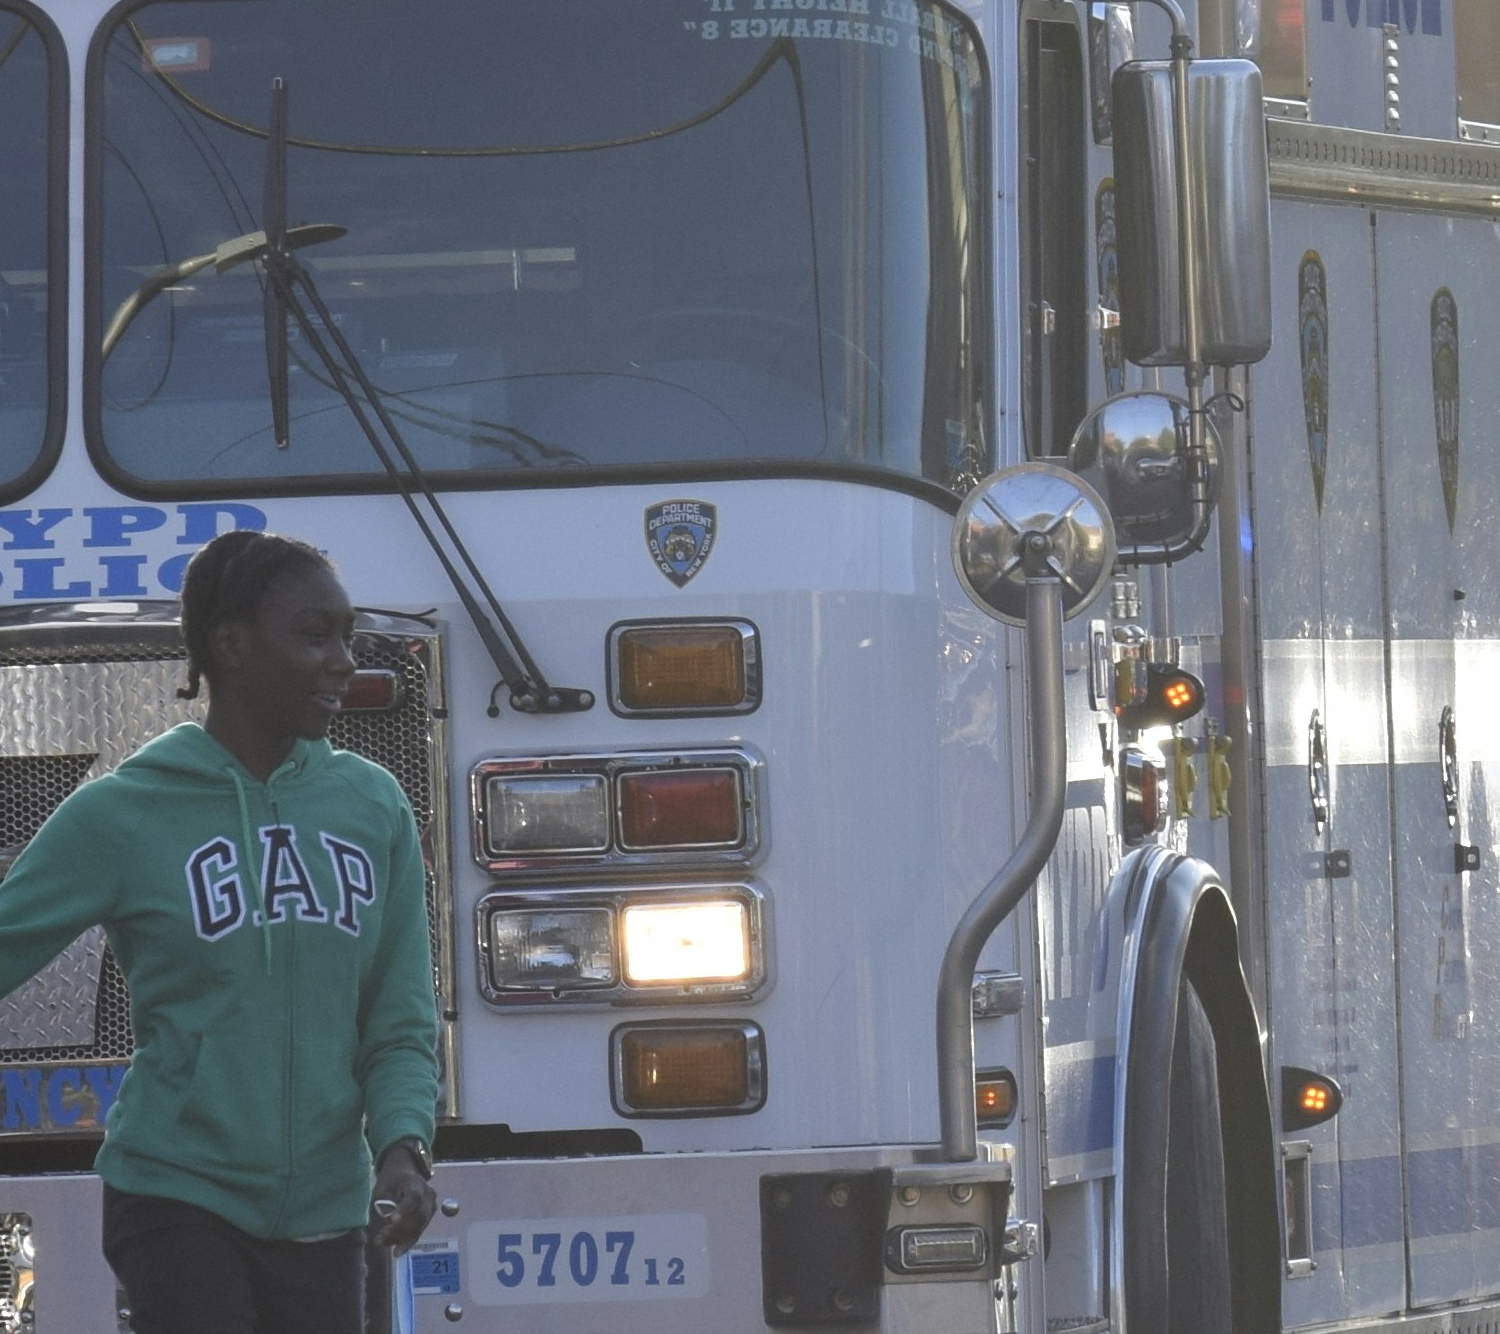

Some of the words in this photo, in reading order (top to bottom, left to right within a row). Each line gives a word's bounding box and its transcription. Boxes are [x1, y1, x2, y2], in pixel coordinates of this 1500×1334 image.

[648, 513, 713, 531] DEPARTMENT
[662, 503, 700, 515] POLICE
[649, 539, 664, 562] CITY
[661, 562, 673, 574] OF
[685, 558, 702, 578] NEW
[699, 533, 713, 557] YORK
[184, 823, 380, 945] GAP
[496, 1231, 636, 1288] 5707
[644, 1257, 686, 1286] 12
